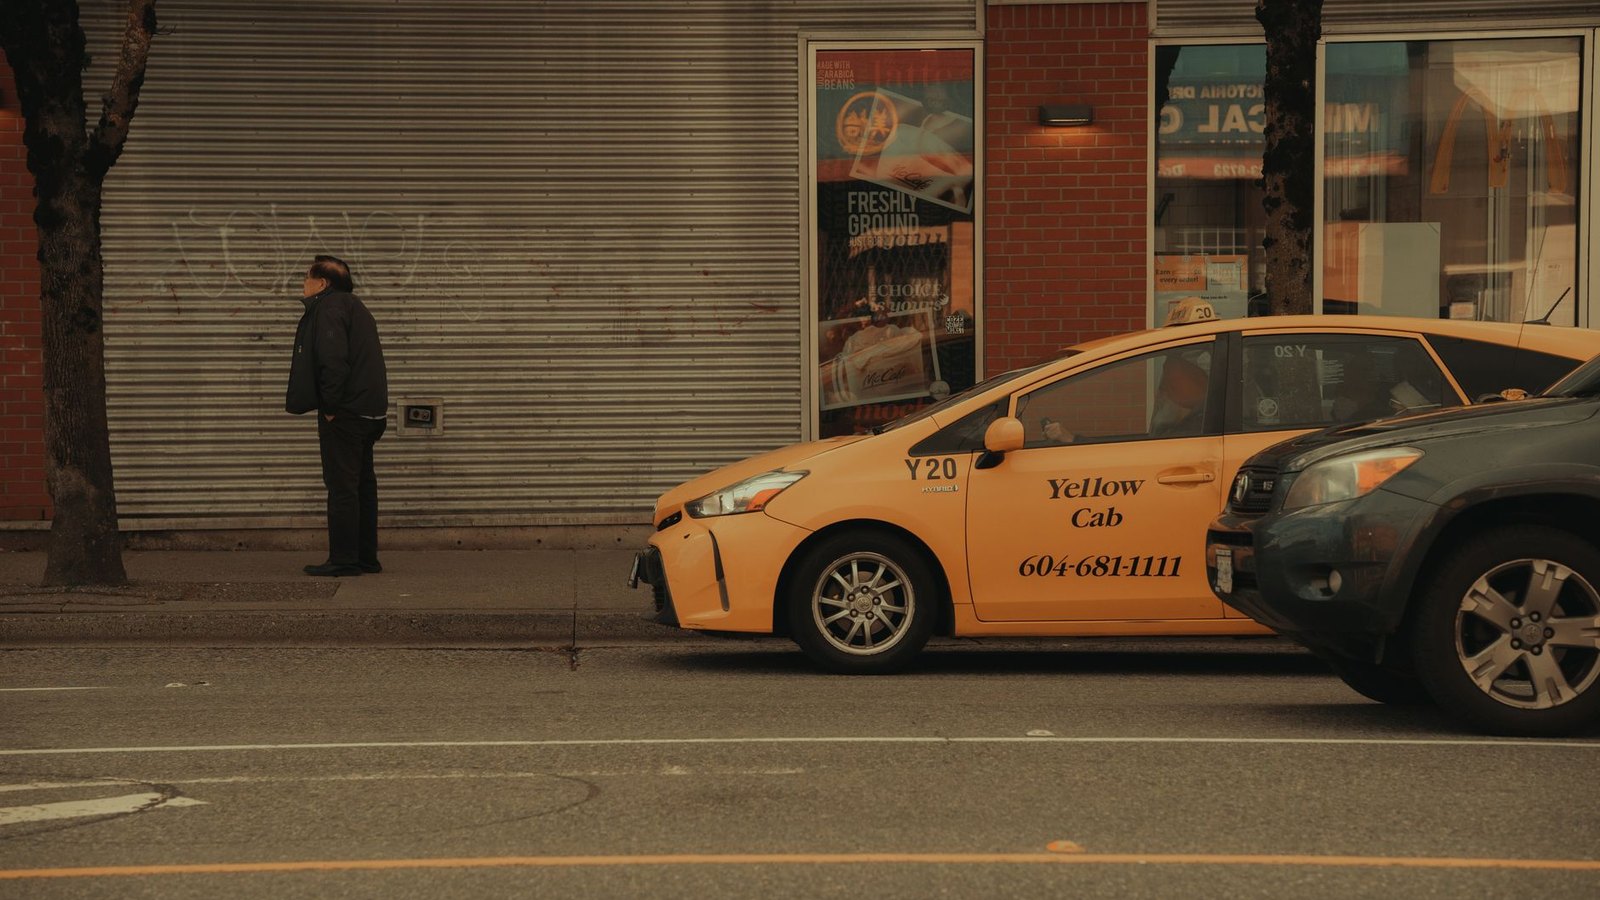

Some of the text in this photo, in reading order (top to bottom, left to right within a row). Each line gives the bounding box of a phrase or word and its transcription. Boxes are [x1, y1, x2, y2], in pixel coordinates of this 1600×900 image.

[825, 70, 854, 78] ARABICA
[834, 61, 850, 69] WITH
[825, 79, 856, 90] BEANS
[848, 191, 919, 213] FRESHLY
[848, 214, 920, 236] GROUND
[877, 284, 943, 297] CHOICE
[1047, 477, 1145, 499] Yellow
[1072, 507, 1123, 528] Cab
[1019, 554, 1182, 577] 604-681-1111
